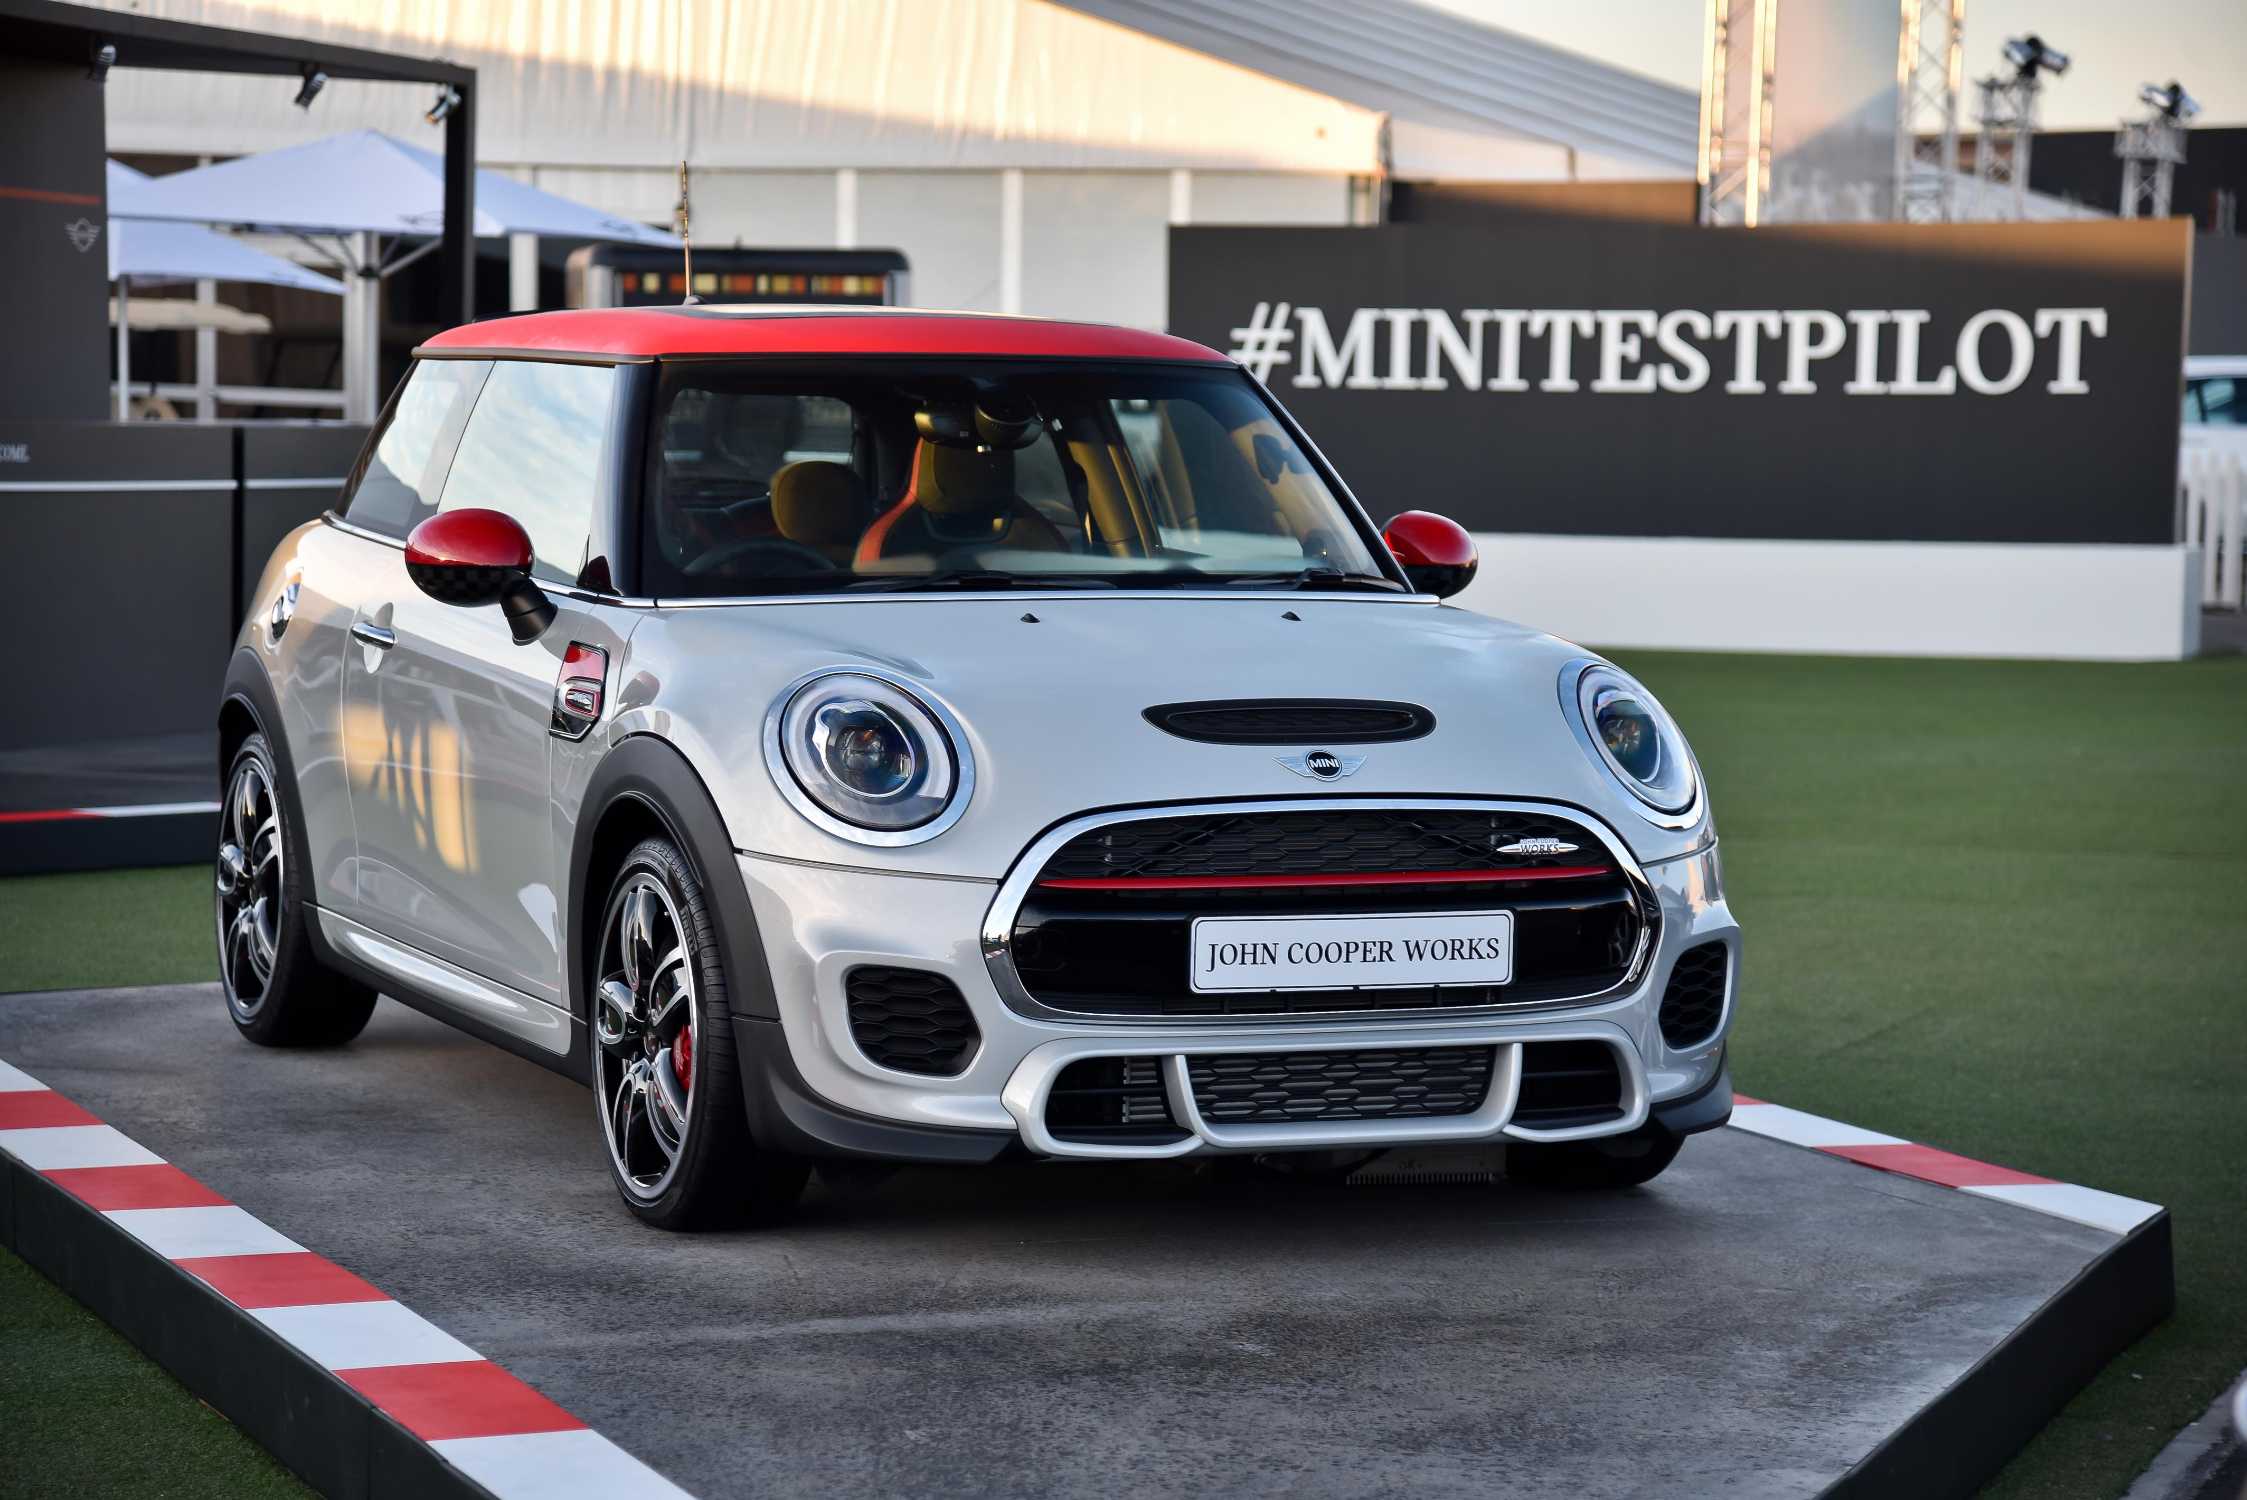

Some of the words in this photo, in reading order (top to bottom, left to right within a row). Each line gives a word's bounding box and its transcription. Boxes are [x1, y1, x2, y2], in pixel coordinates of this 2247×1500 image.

[1229, 301, 2108, 396] #MINITESTPILOT
[1309, 758, 1340, 768] MINI
[1520, 844, 1560, 855] WORKS
[1206, 942, 1279, 973] JOHN
[1287, 940, 1397, 966] COOPER
[1402, 937, 1500, 961] WORKS
